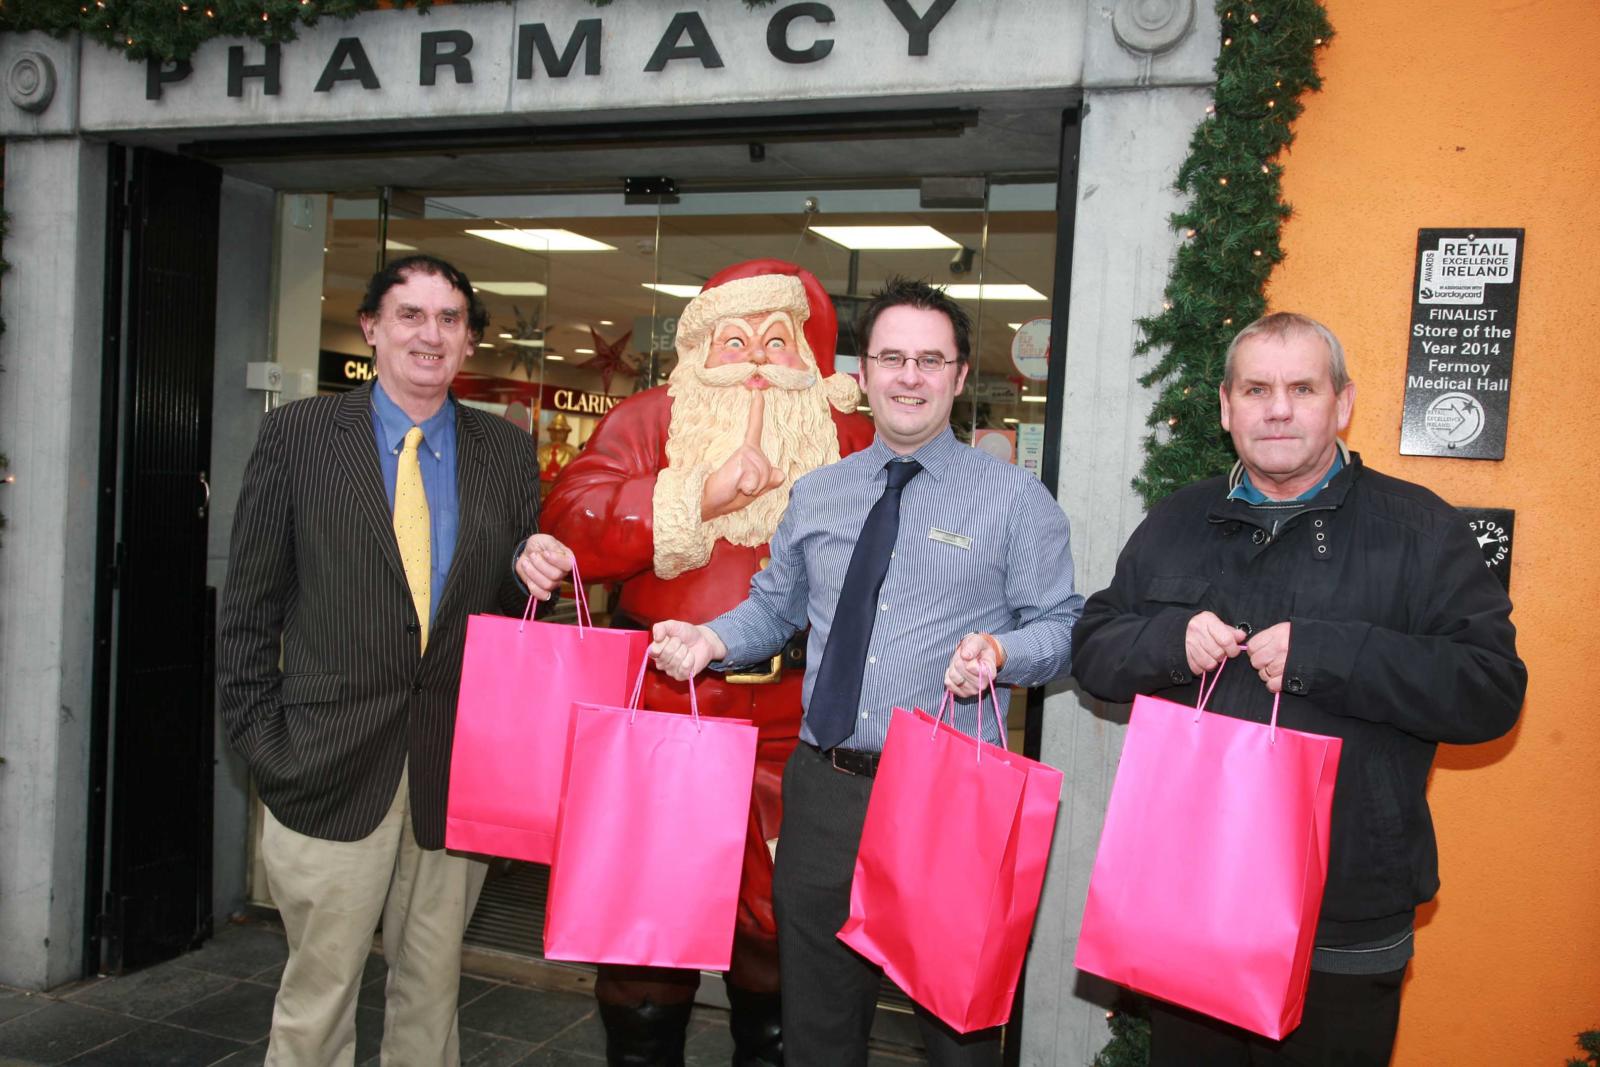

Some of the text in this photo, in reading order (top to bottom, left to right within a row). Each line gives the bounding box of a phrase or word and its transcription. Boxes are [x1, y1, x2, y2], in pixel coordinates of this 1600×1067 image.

[146, 0, 958, 99] PHARMACY
[1444, 243, 1509, 256] RETAIL
[1424, 252, 1434, 282] AWARDS
[1442, 257, 1509, 265] EXCELLENCE
[1441, 266, 1509, 277] IRELAND
[1434, 291, 1482, 299] barclaycard
[1429, 308, 1498, 321] FINALIST
[1413, 323, 1511, 338] Store of the
[1421, 341, 1500, 355] Year 2014
[1428, 359, 1491, 376] Fermoy
[1408, 375, 1508, 391] Medical Hall
[1469, 520, 1509, 543] STORE
[1485, 546, 1509, 568] 2014
